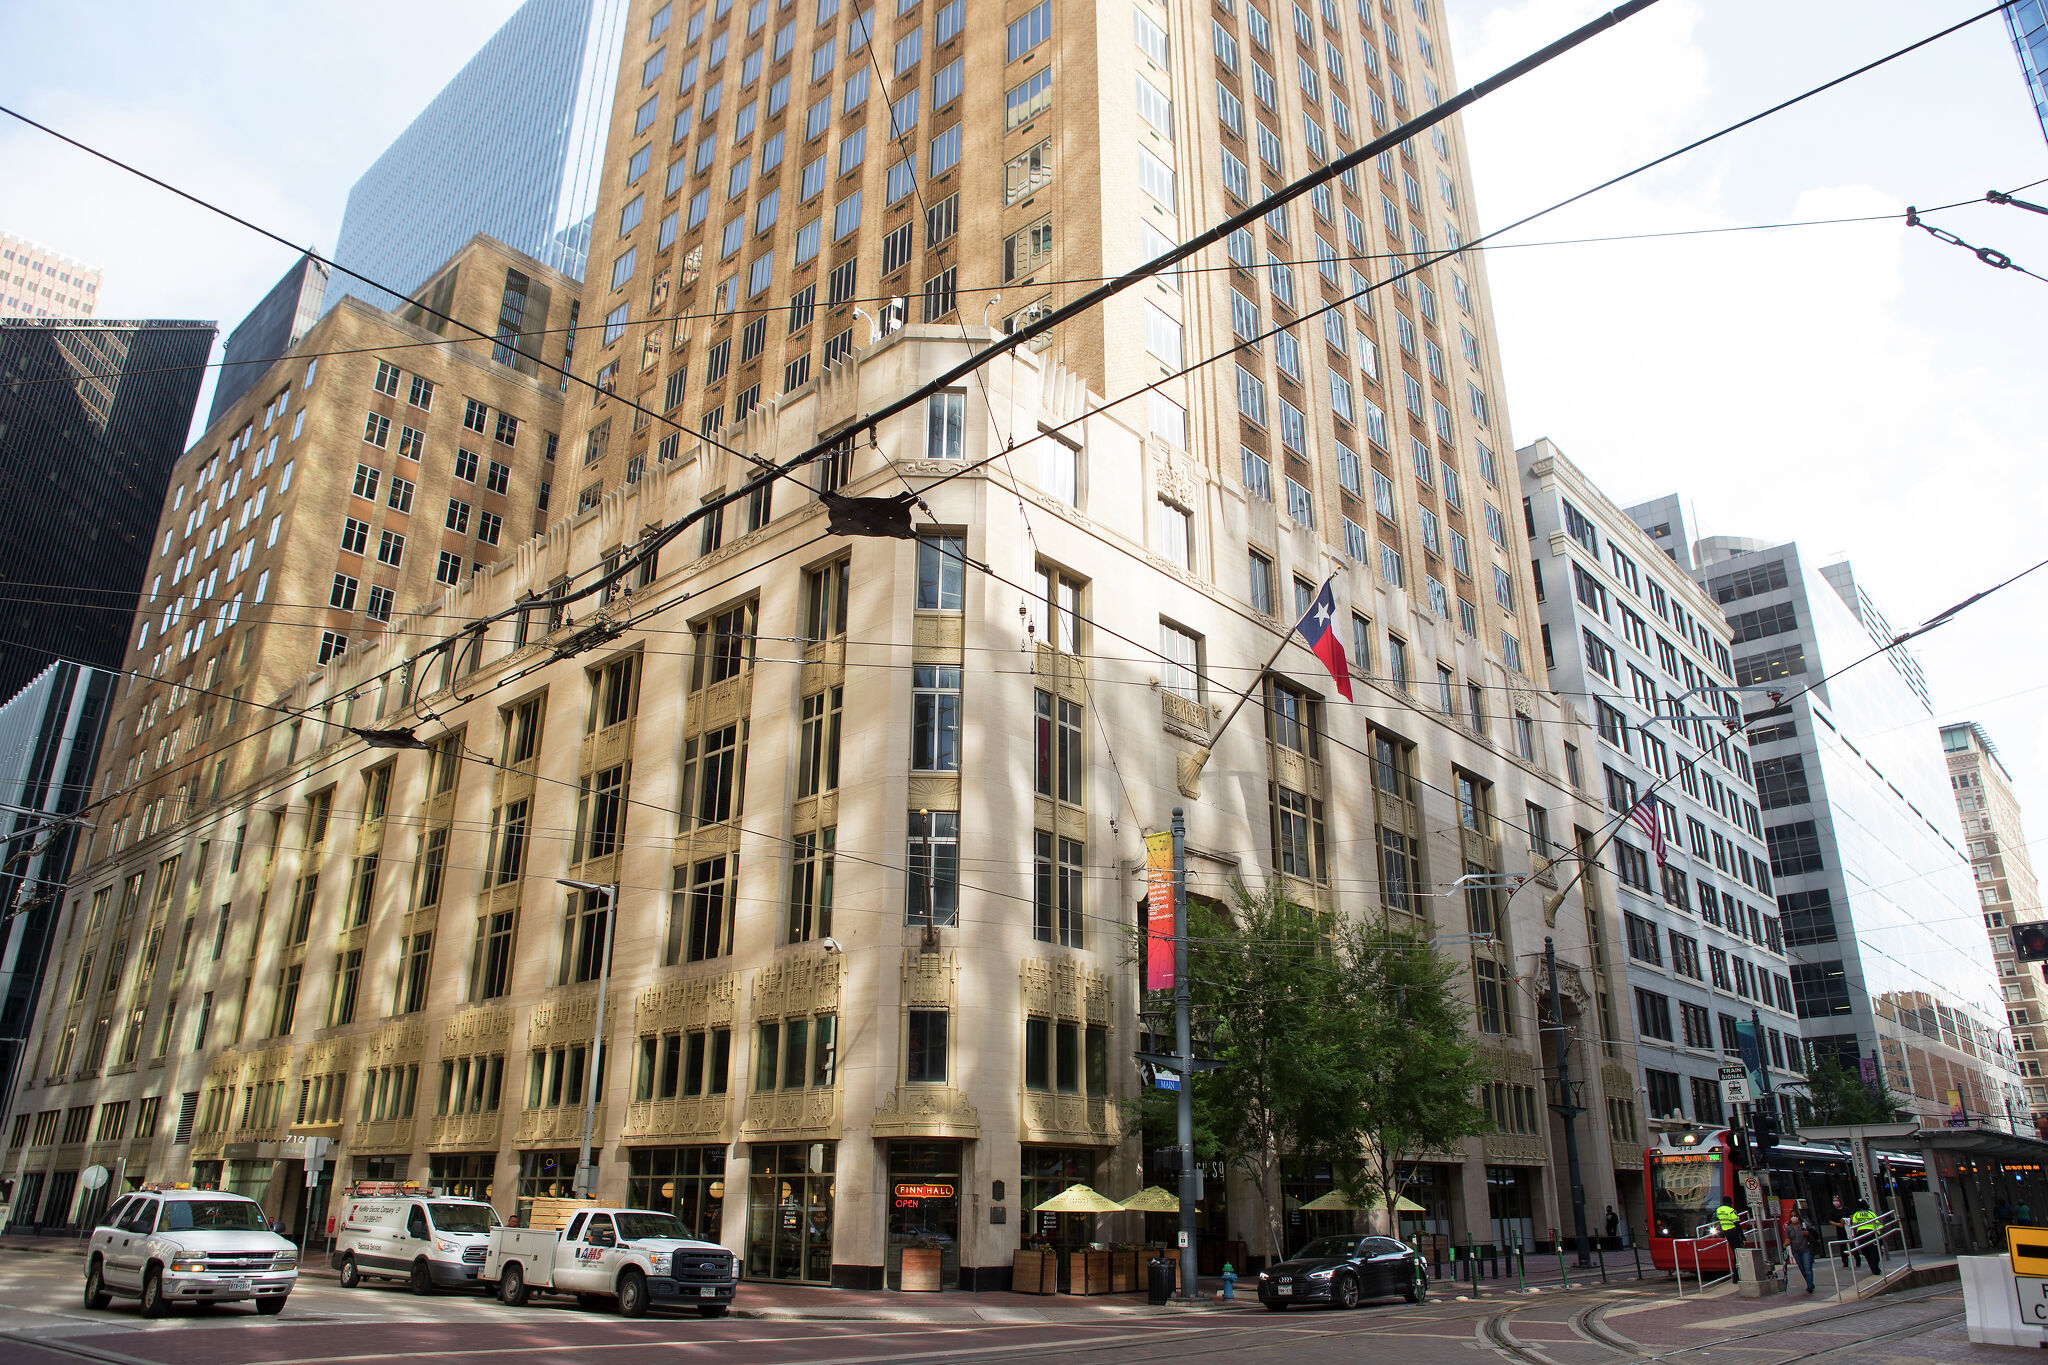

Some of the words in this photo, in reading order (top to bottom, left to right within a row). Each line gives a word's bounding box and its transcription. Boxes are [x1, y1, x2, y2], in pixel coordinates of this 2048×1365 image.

[1160, 1080, 1175, 1090] MAIN
[286, 1135, 305, 1144] 712
[1854, 1141, 1866, 1179] CENTRAL
[900, 1186, 923, 1194] FINN
[926, 1187, 951, 1195] HALL
[895, 1199, 919, 1208] OPEN
[380, 1205, 394, 1214] Company
[580, 1247, 604, 1260] AMS
